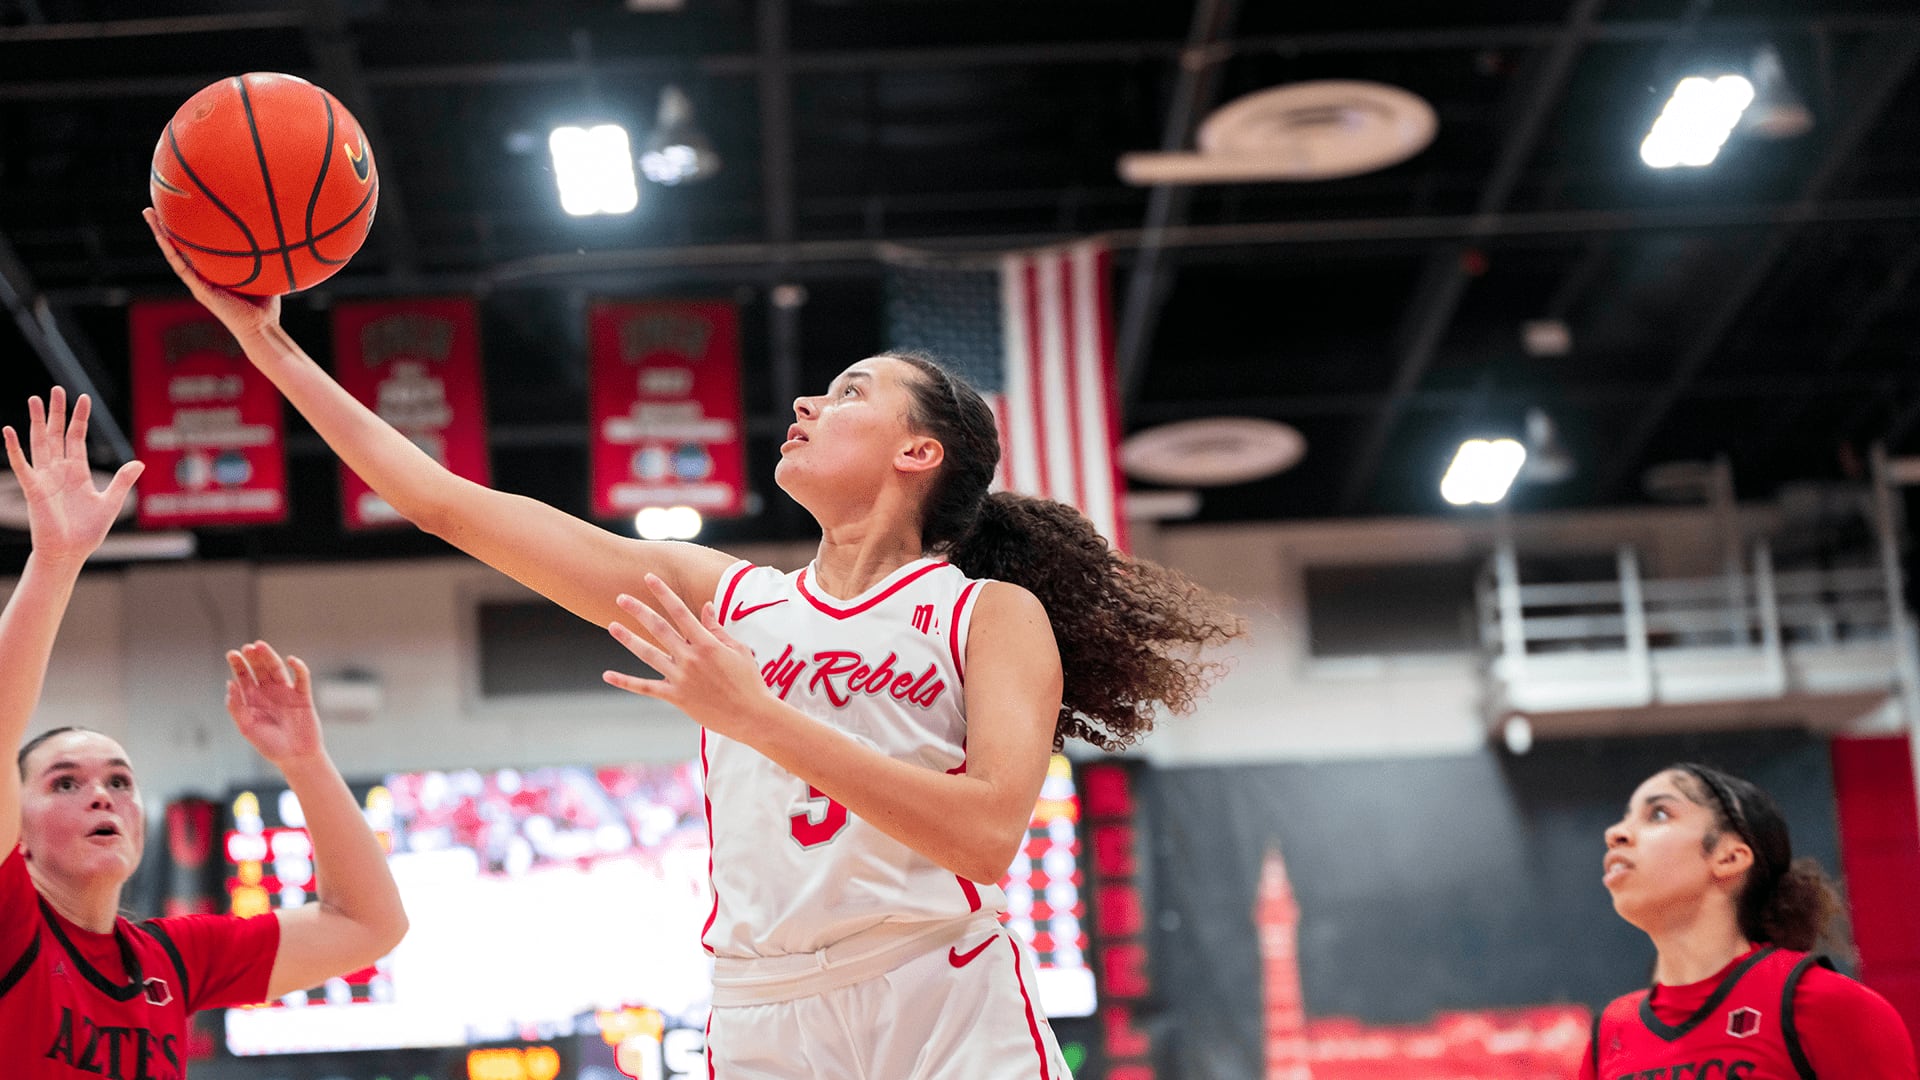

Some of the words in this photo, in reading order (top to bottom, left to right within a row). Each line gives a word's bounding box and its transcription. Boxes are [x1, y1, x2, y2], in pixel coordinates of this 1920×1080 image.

[751, 643, 808, 702] dy
[809, 650, 946, 709] Rebels
[45, 1006, 180, 1080] AZTES
